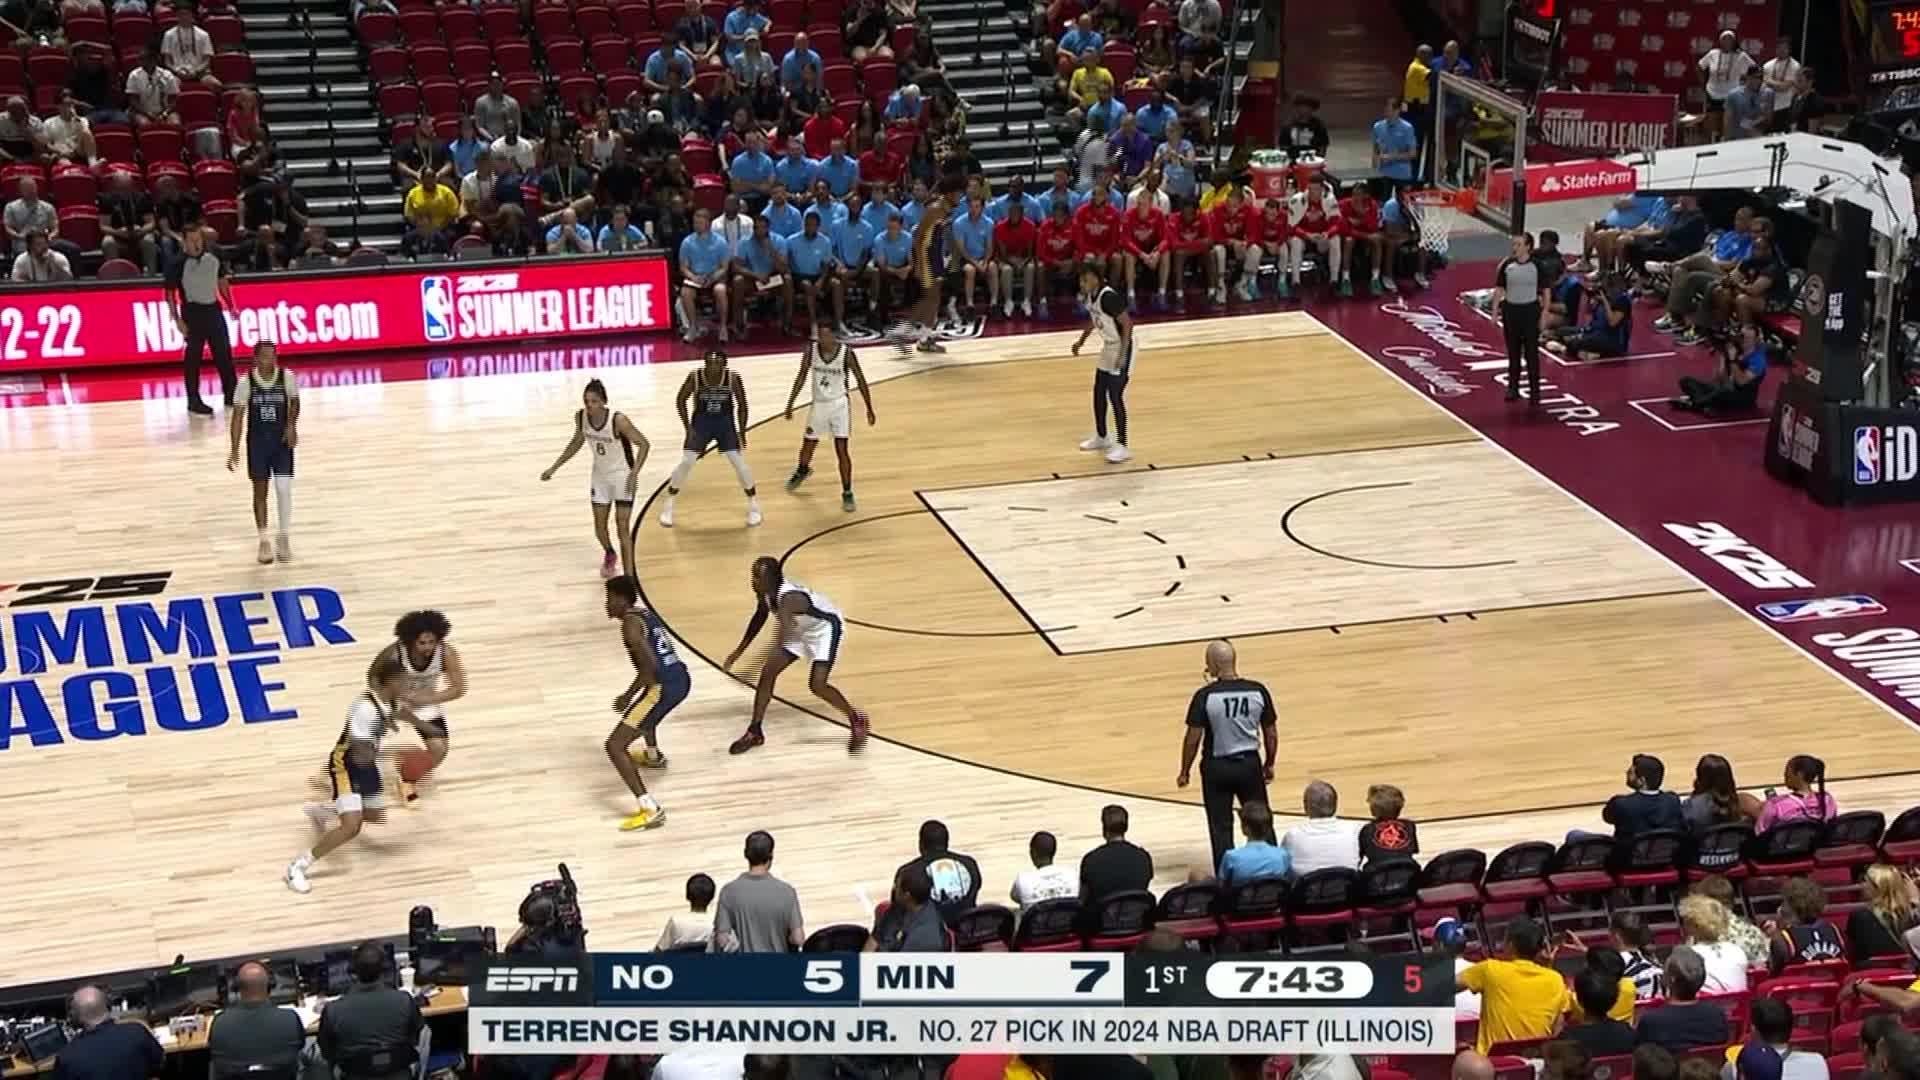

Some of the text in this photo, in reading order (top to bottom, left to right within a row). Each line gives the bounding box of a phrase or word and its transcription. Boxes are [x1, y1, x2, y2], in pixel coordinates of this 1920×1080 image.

[1541, 119, 1667, 153] SUMMER LEAGUE
[0, 304, 86, 361] 2-22
[457, 283, 656, 339] SUMMER LEAGUE
[1659, 520, 1816, 589] 2K25
[1223, 696, 1251, 719] 174
